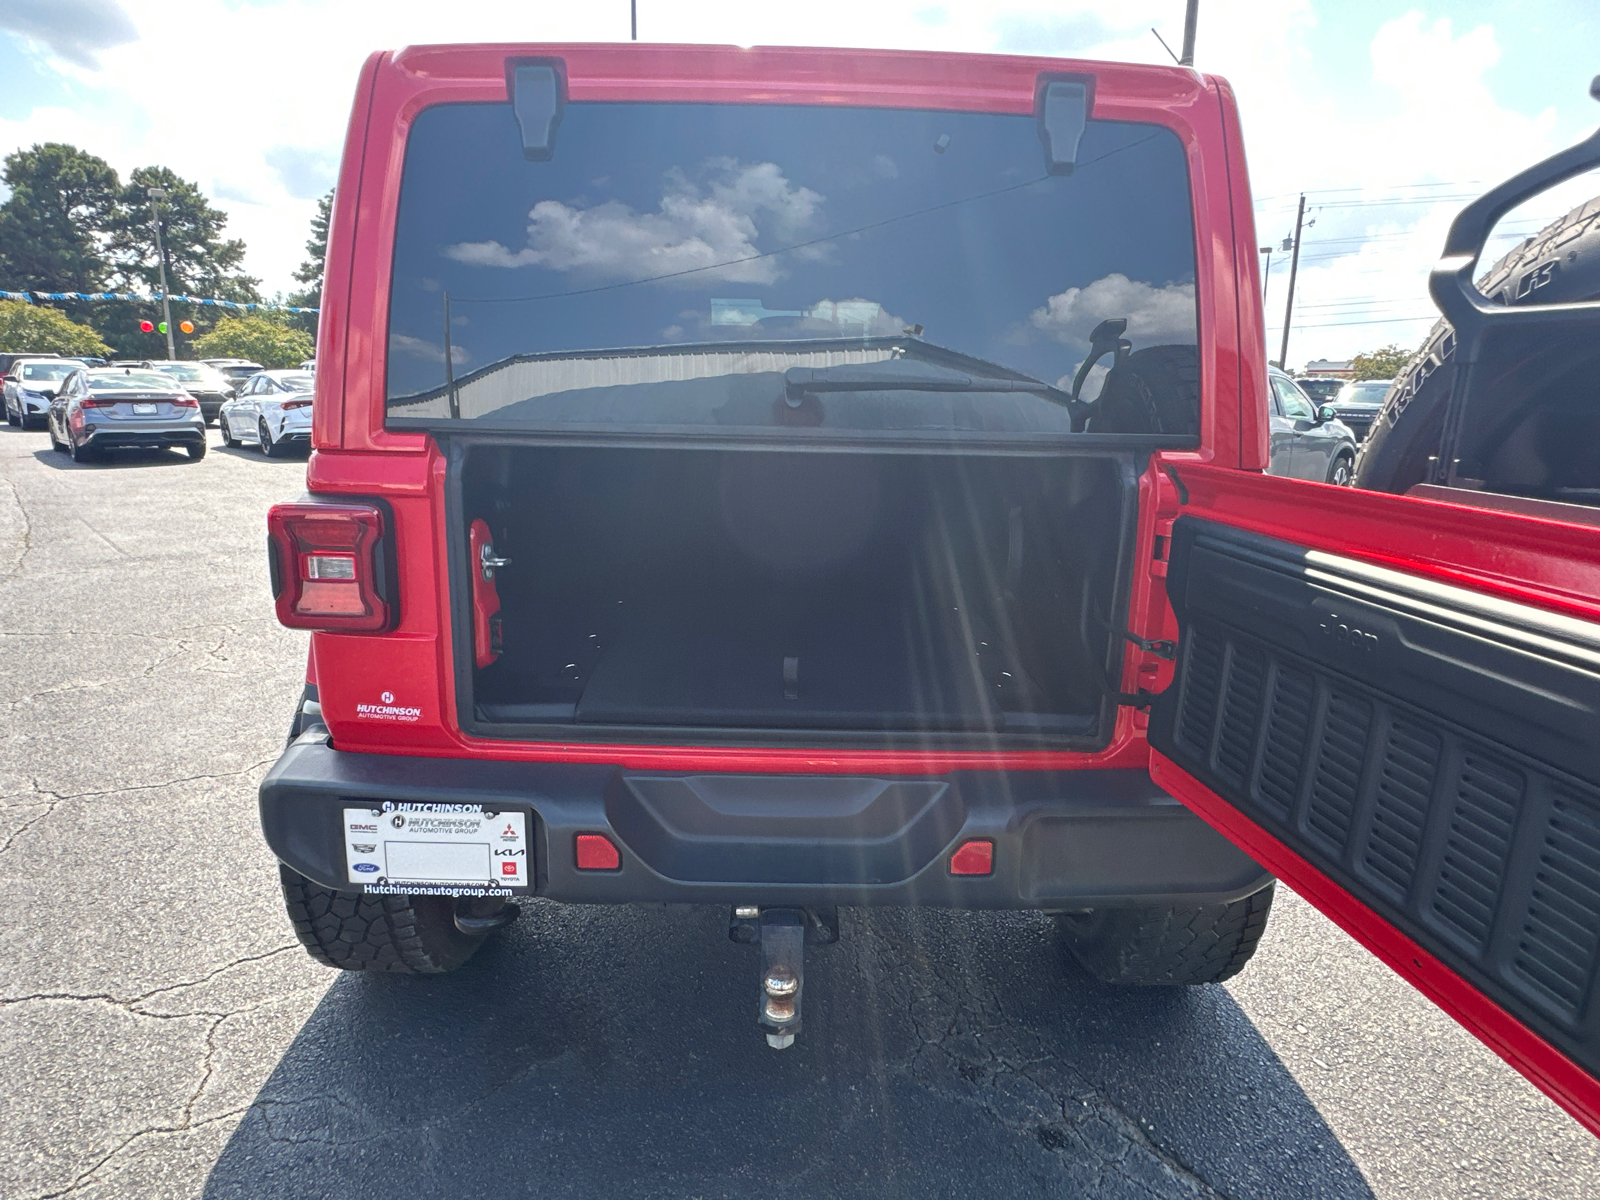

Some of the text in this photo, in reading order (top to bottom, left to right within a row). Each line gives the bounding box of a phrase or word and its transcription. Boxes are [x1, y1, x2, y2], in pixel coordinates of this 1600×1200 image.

[357, 704, 421, 716] HUTCHINSON
[358, 712, 396, 720] AUTOMOTIVE
[398, 803, 482, 813] HUTCHINSON
[408, 817, 482, 828] HUTCHINSON
[494, 848, 525, 856] KIA
[364, 884, 513, 898] Hutchinsonautogroup.com
